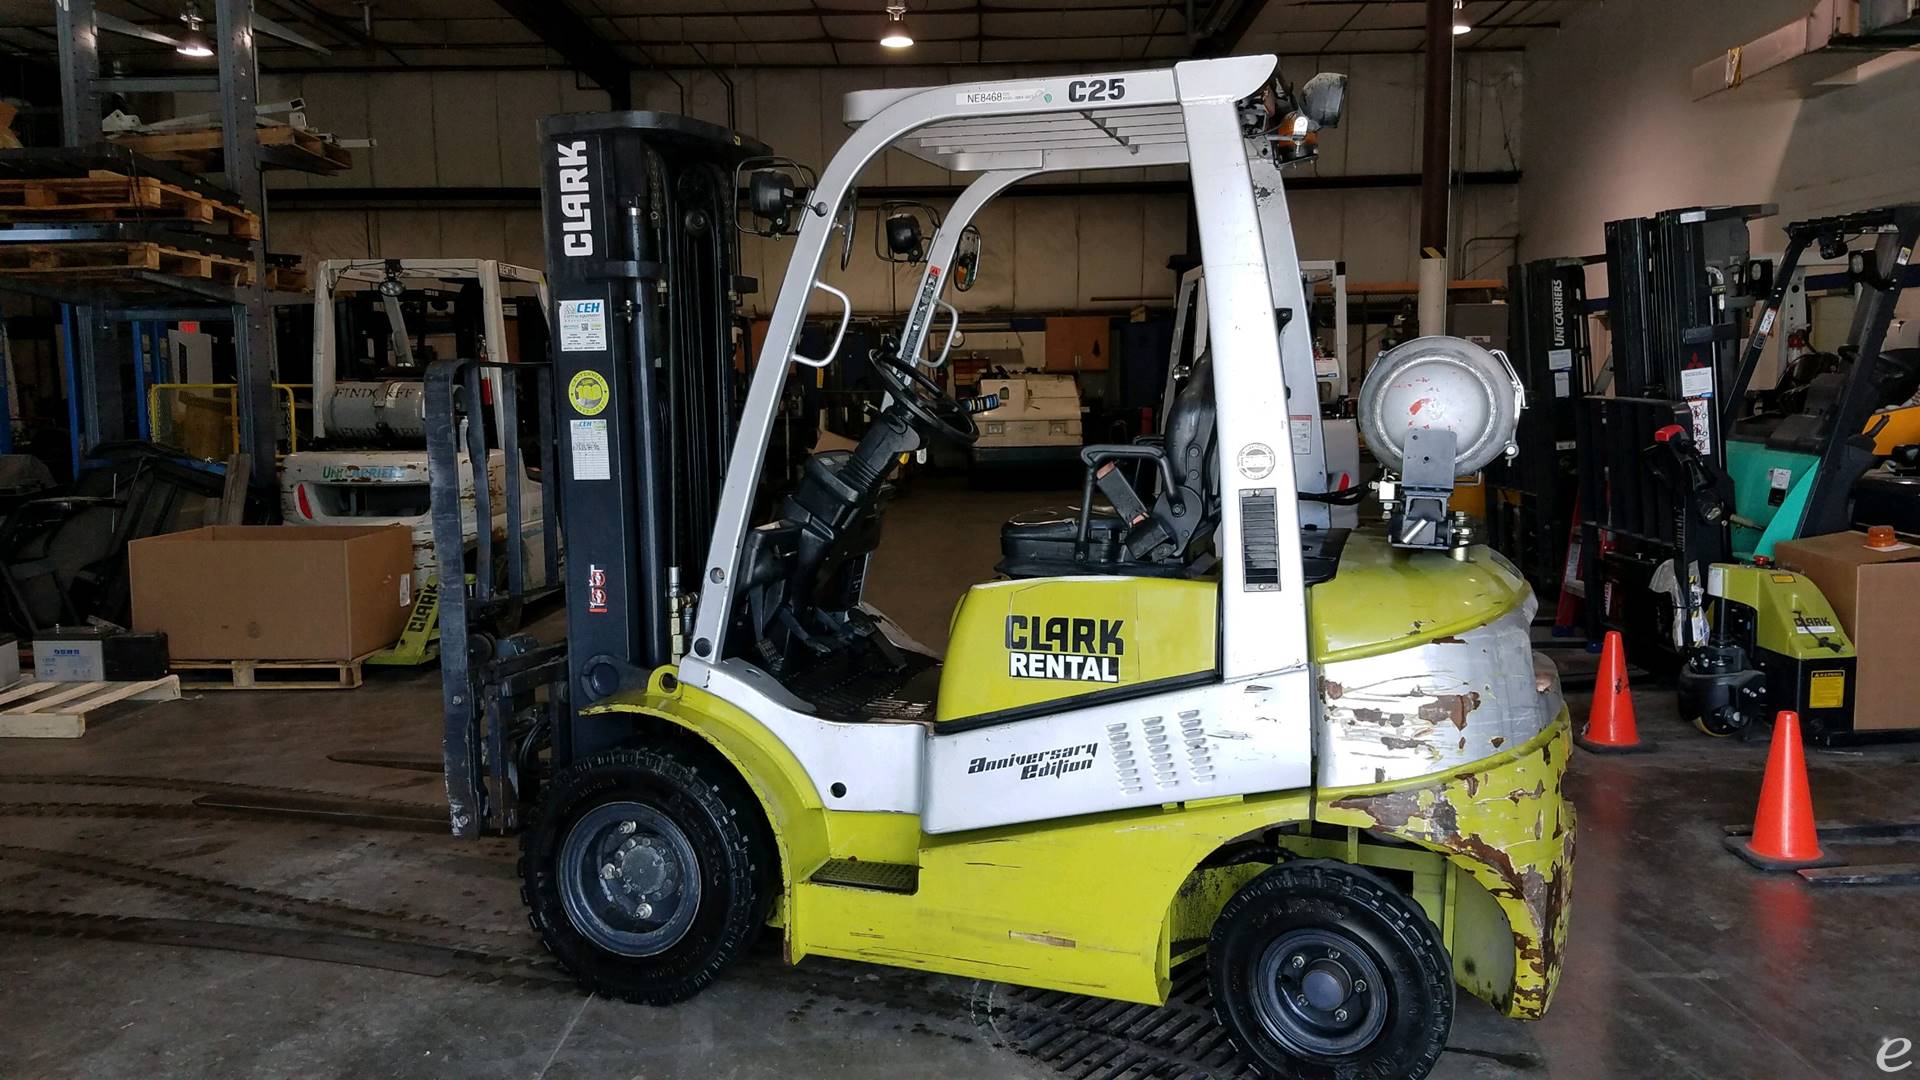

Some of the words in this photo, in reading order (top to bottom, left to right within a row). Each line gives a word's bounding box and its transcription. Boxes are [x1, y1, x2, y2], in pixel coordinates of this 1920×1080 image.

[967, 93, 1002, 104] NE8468
[1068, 78, 1126, 103] C25
[557, 140, 594, 257] CLARK
[576, 302, 600, 313] CEH
[1553, 279, 1565, 347] UNICARRIERS
[407, 583, 438, 633] CLARK
[1005, 615, 1124, 656] CLARK
[1010, 653, 1118, 683] RENTAL
